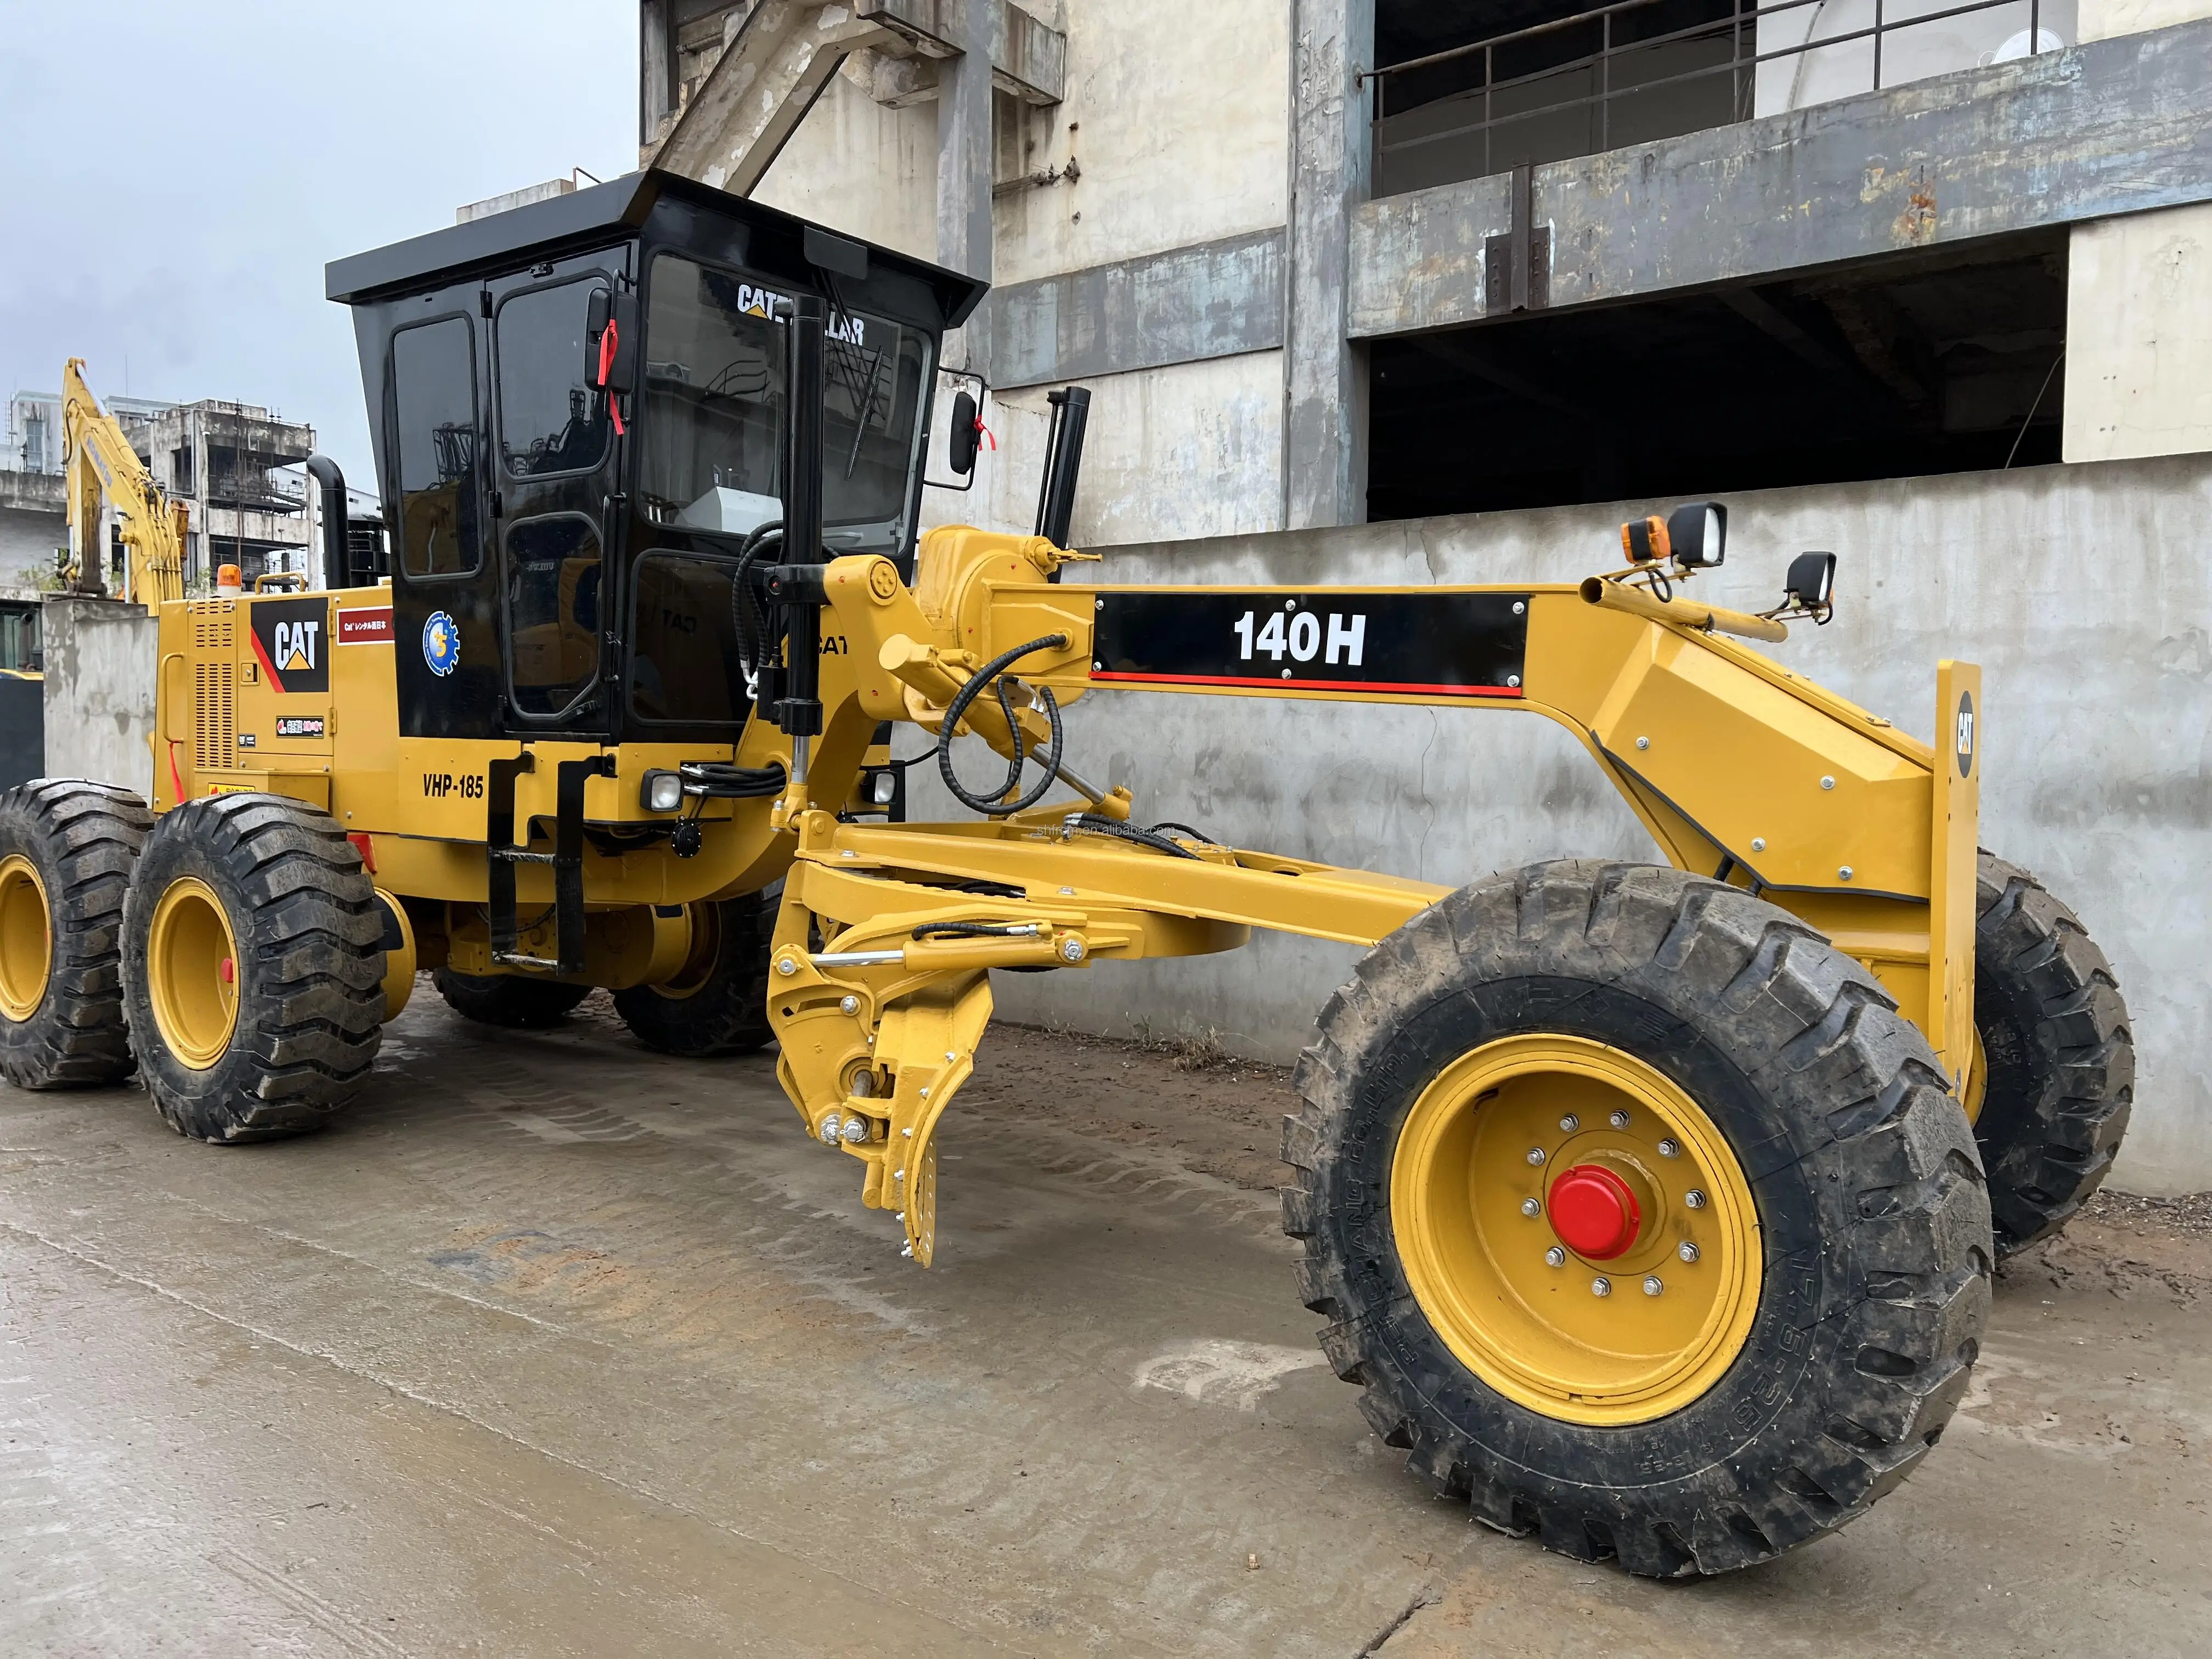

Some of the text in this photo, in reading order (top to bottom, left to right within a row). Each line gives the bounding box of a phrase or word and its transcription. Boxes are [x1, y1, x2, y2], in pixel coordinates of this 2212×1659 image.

[737, 284, 864, 346] CATLAR
[275, 621, 318, 670] CAT
[819, 635, 848, 654] AT
[1957, 712, 1973, 754] CAT
[423, 773, 483, 798] VHP-185
